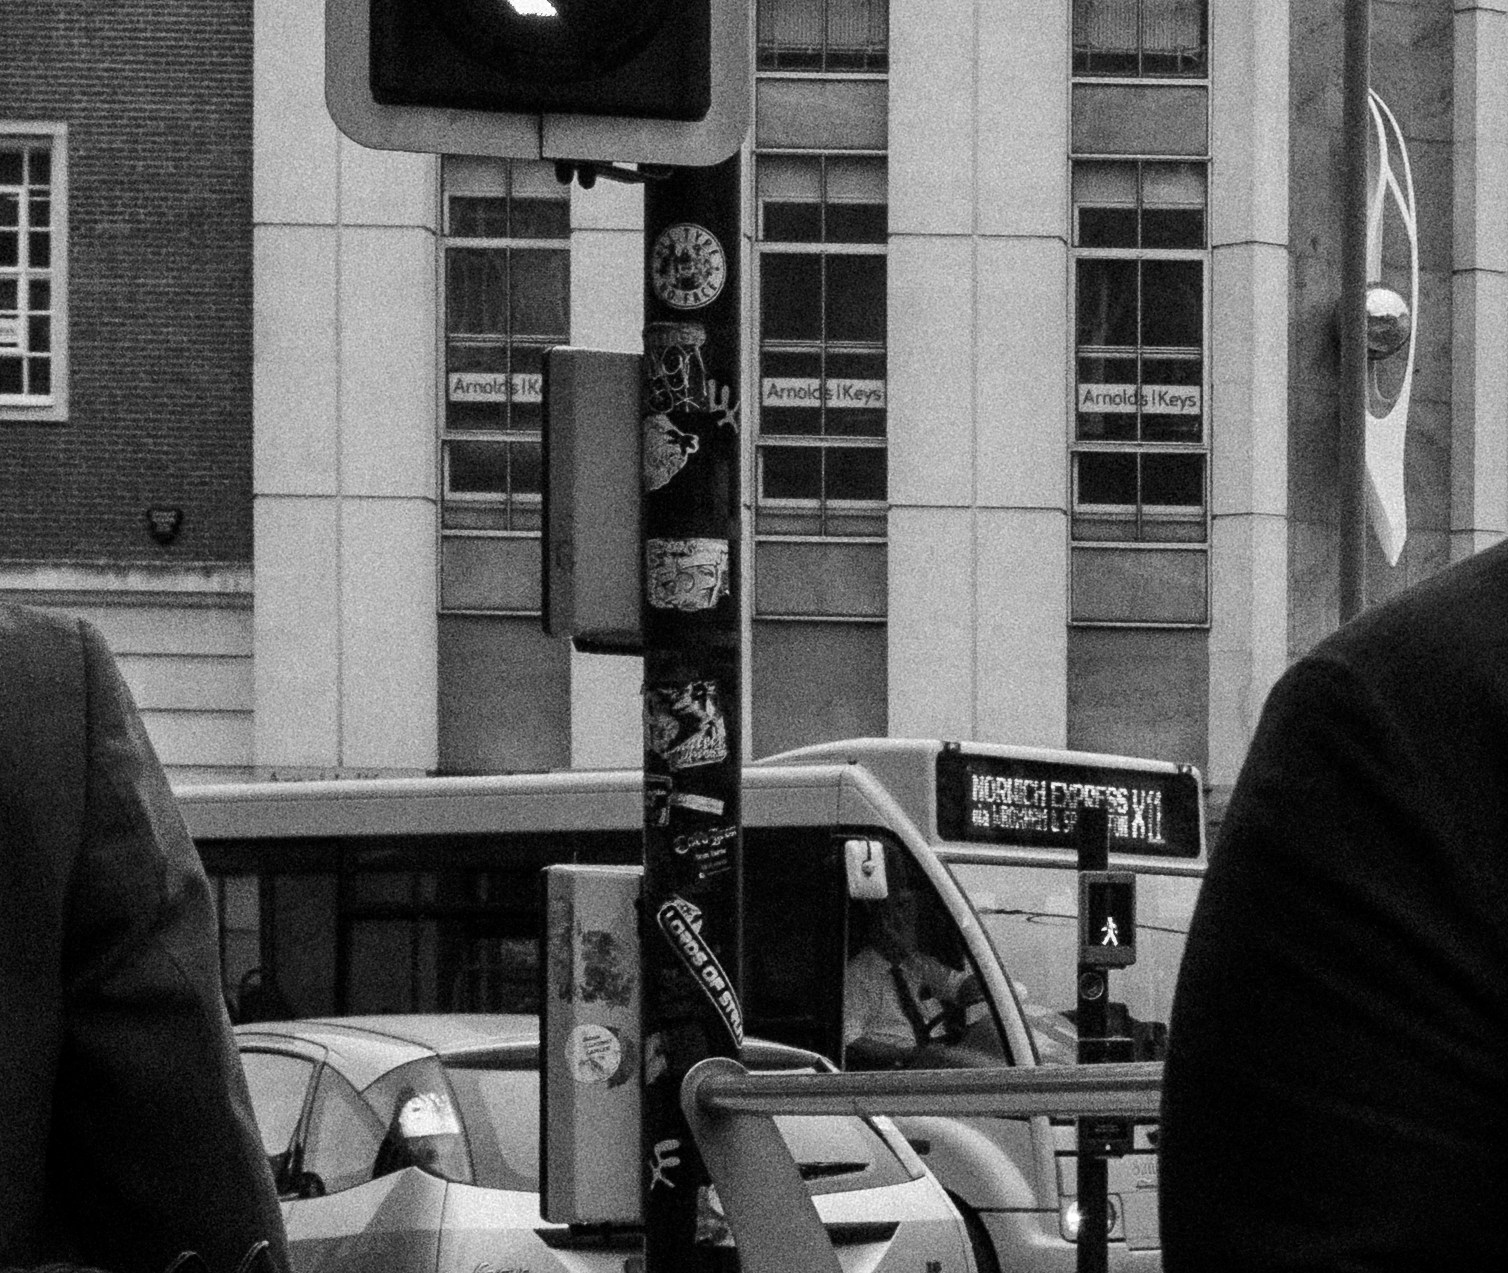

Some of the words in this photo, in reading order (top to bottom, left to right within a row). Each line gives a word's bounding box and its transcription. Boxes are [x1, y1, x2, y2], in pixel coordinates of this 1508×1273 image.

[452, 377, 521, 396] Arnolds
[767, 382, 834, 401] Arnolds
[843, 383, 882, 406] Keys
[1082, 388, 1149, 407] Arnolds
[1158, 389, 1198, 412] Keys
[971, 774, 1047, 808] NORWICH
[701, 965, 726, 992] OF
